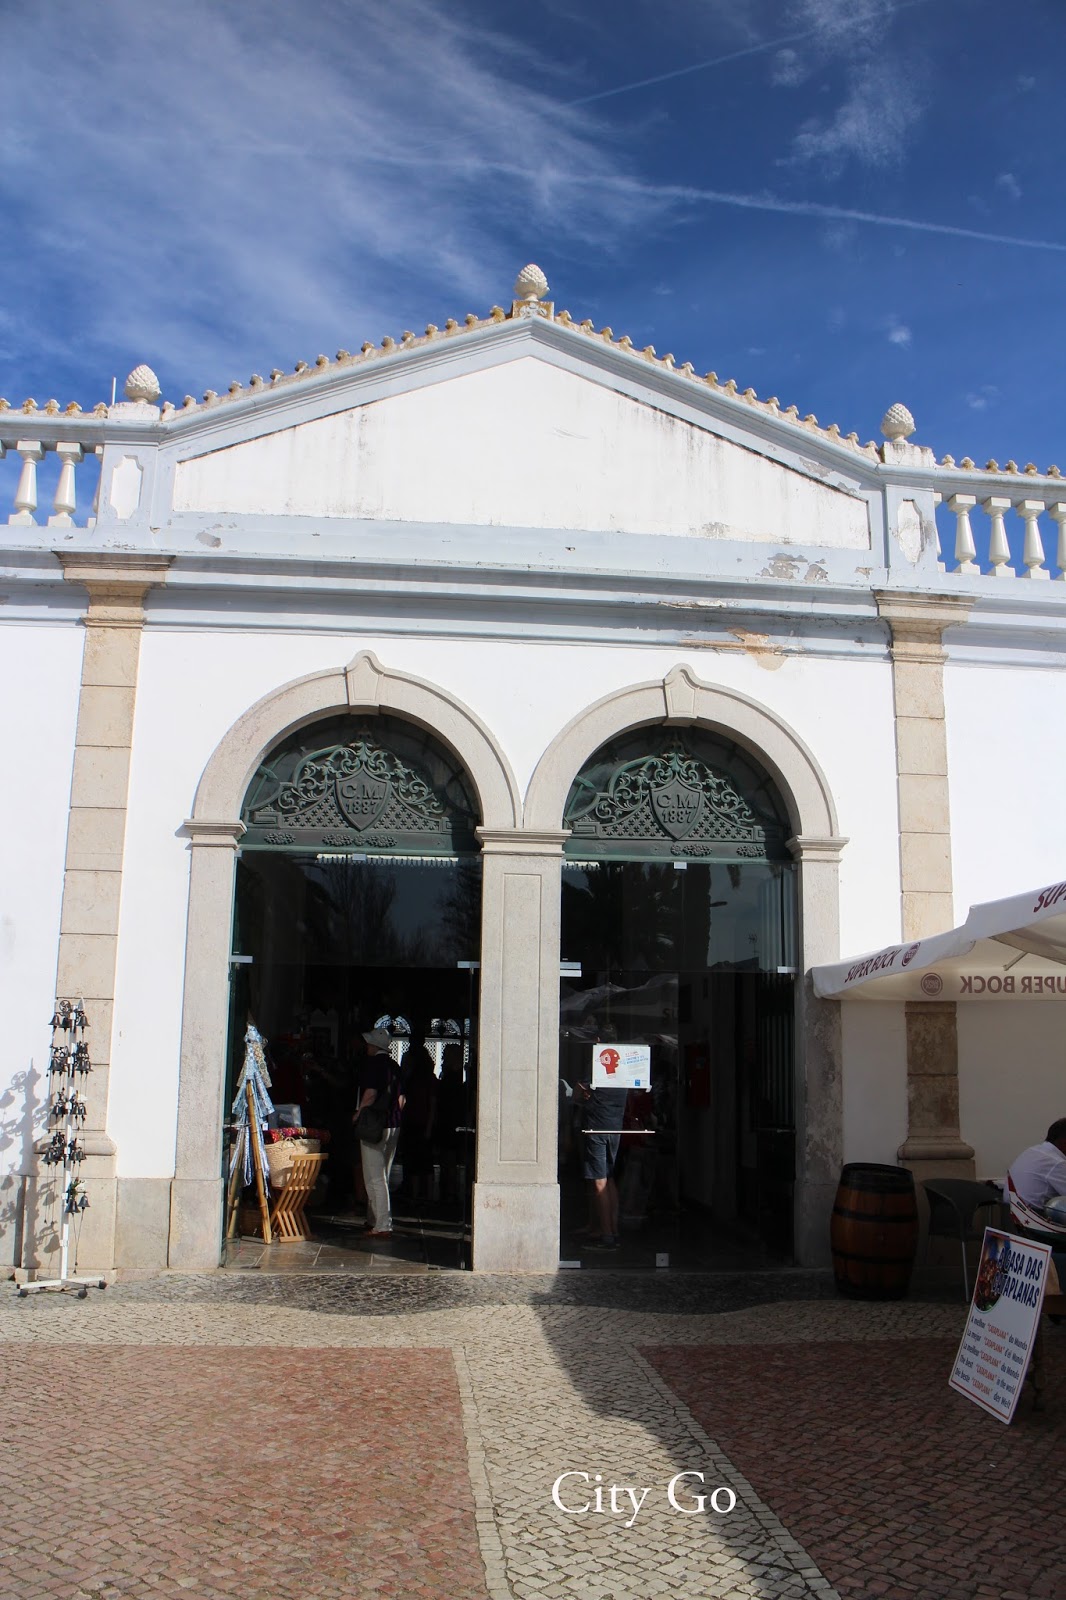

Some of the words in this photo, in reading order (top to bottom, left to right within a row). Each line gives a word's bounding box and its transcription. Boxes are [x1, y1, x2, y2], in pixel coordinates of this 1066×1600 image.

[346, 800, 377, 814] 1887
[662, 809, 693, 823] 1887
[1033, 884, 1066, 913] SUP
[844, 958, 874, 983] SUPER
[870, 949, 902, 974] BOCK
[997, 1247, 1005, 1269] A
[1004, 1249, 1025, 1275] CASA
[1025, 1256, 1043, 1281] DAS
[992, 1271, 1040, 1308] CATAPLANAS
